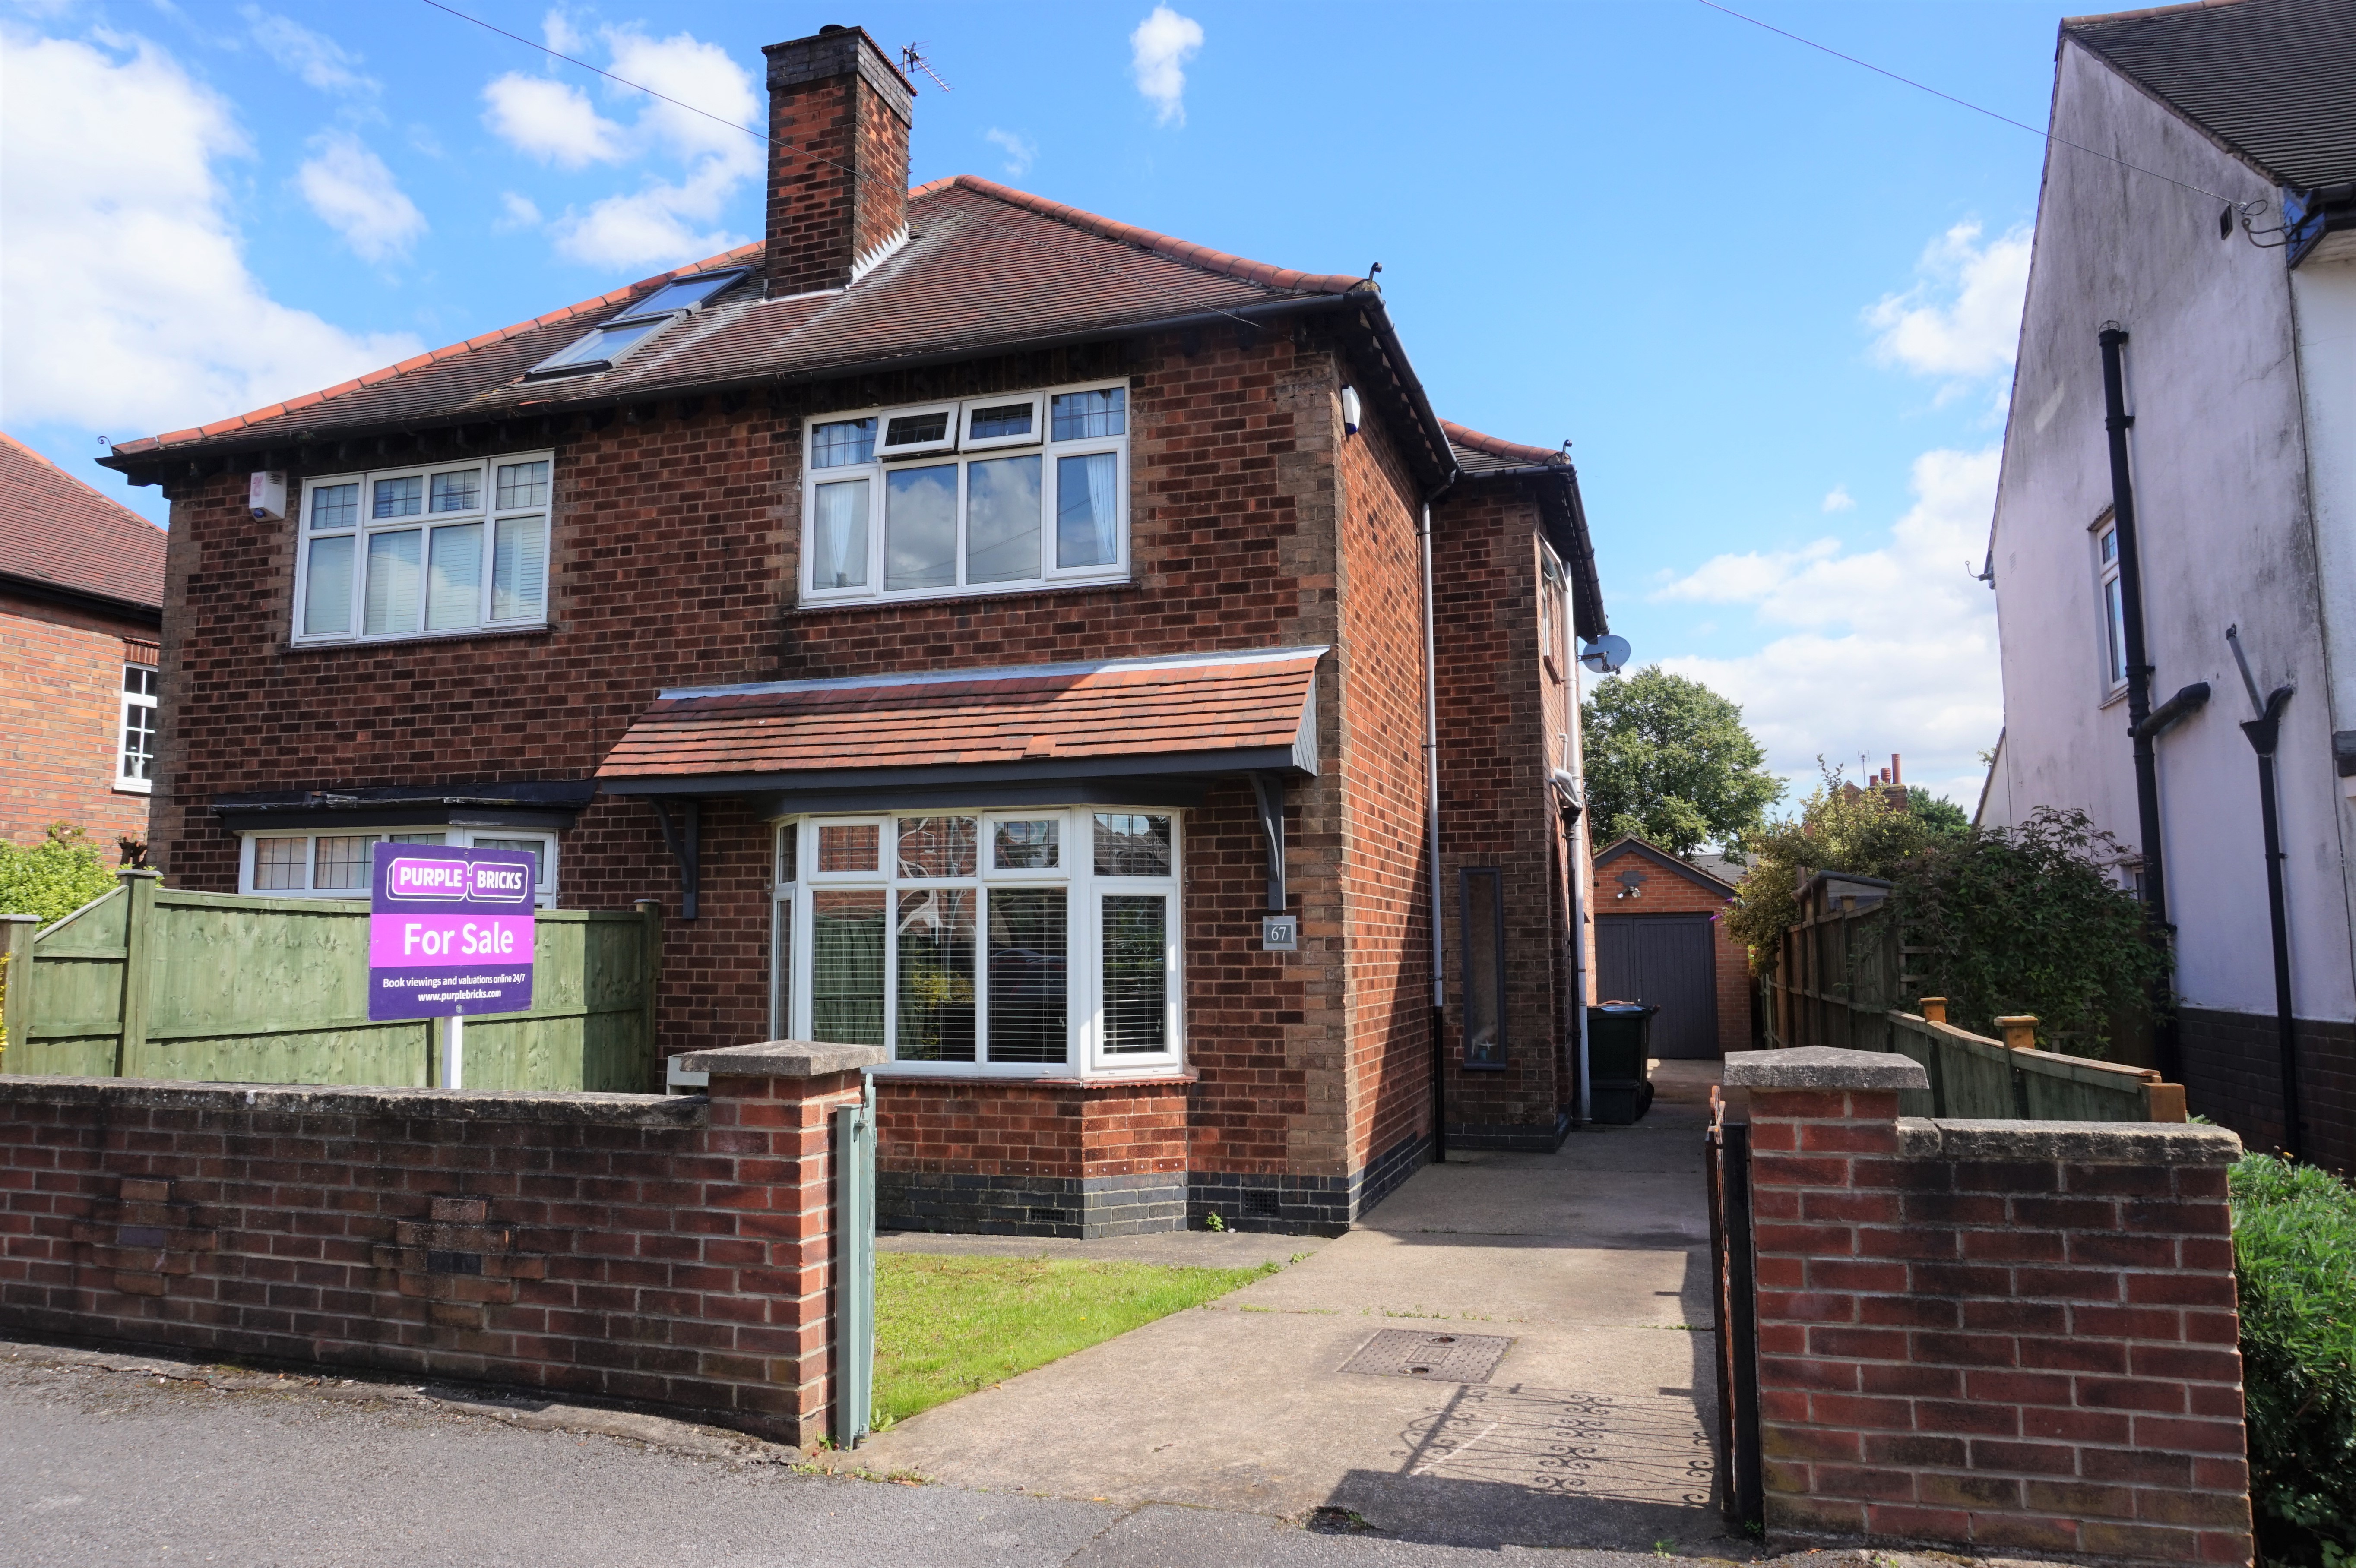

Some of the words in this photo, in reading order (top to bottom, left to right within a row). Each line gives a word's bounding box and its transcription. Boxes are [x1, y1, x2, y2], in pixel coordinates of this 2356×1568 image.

[400, 867, 462, 887] PURPLE
[477, 870, 522, 889] BRICKS
[405, 923, 455, 955] For
[461, 922, 513, 954] Sale
[1271, 926, 1286, 941] 67
[383, 977, 405, 988] Book
[406, 977, 442, 988] viewings
[443, 975, 457, 986] and
[459, 975, 493, 985] valuations
[494, 974, 512, 983] online
[513, 973, 526, 984] 24/7
[418, 989, 501, 1002] www.purplebricks.com
